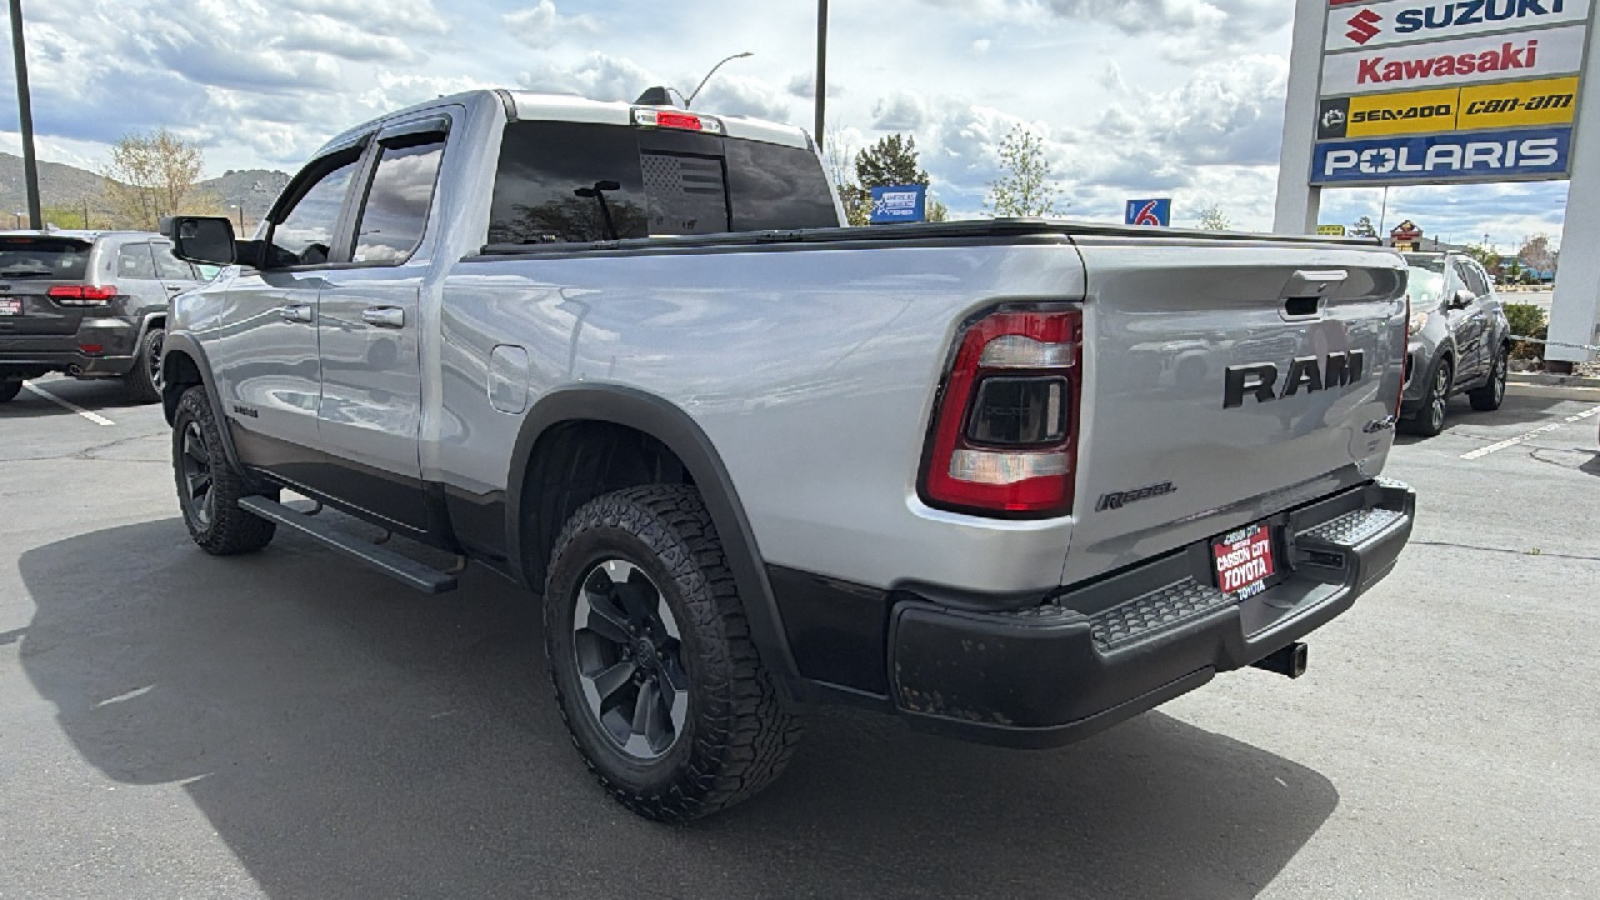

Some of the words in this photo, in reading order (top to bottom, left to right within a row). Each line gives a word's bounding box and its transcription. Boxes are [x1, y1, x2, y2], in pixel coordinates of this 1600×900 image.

[1395, 0, 1564, 33] SUZUKI
[1357, 39, 1538, 84] Kawasaki
[1465, 93, 1573, 116] can-am
[1324, 138, 1558, 176] POLARIS
[1222, 349, 1364, 410] RAM
[1216, 546, 1251, 572] CARSON
[1251, 538, 1269, 558] CITY
[1224, 556, 1267, 591] TOYOTA
[1238, 579, 1266, 601] TOYOTA
